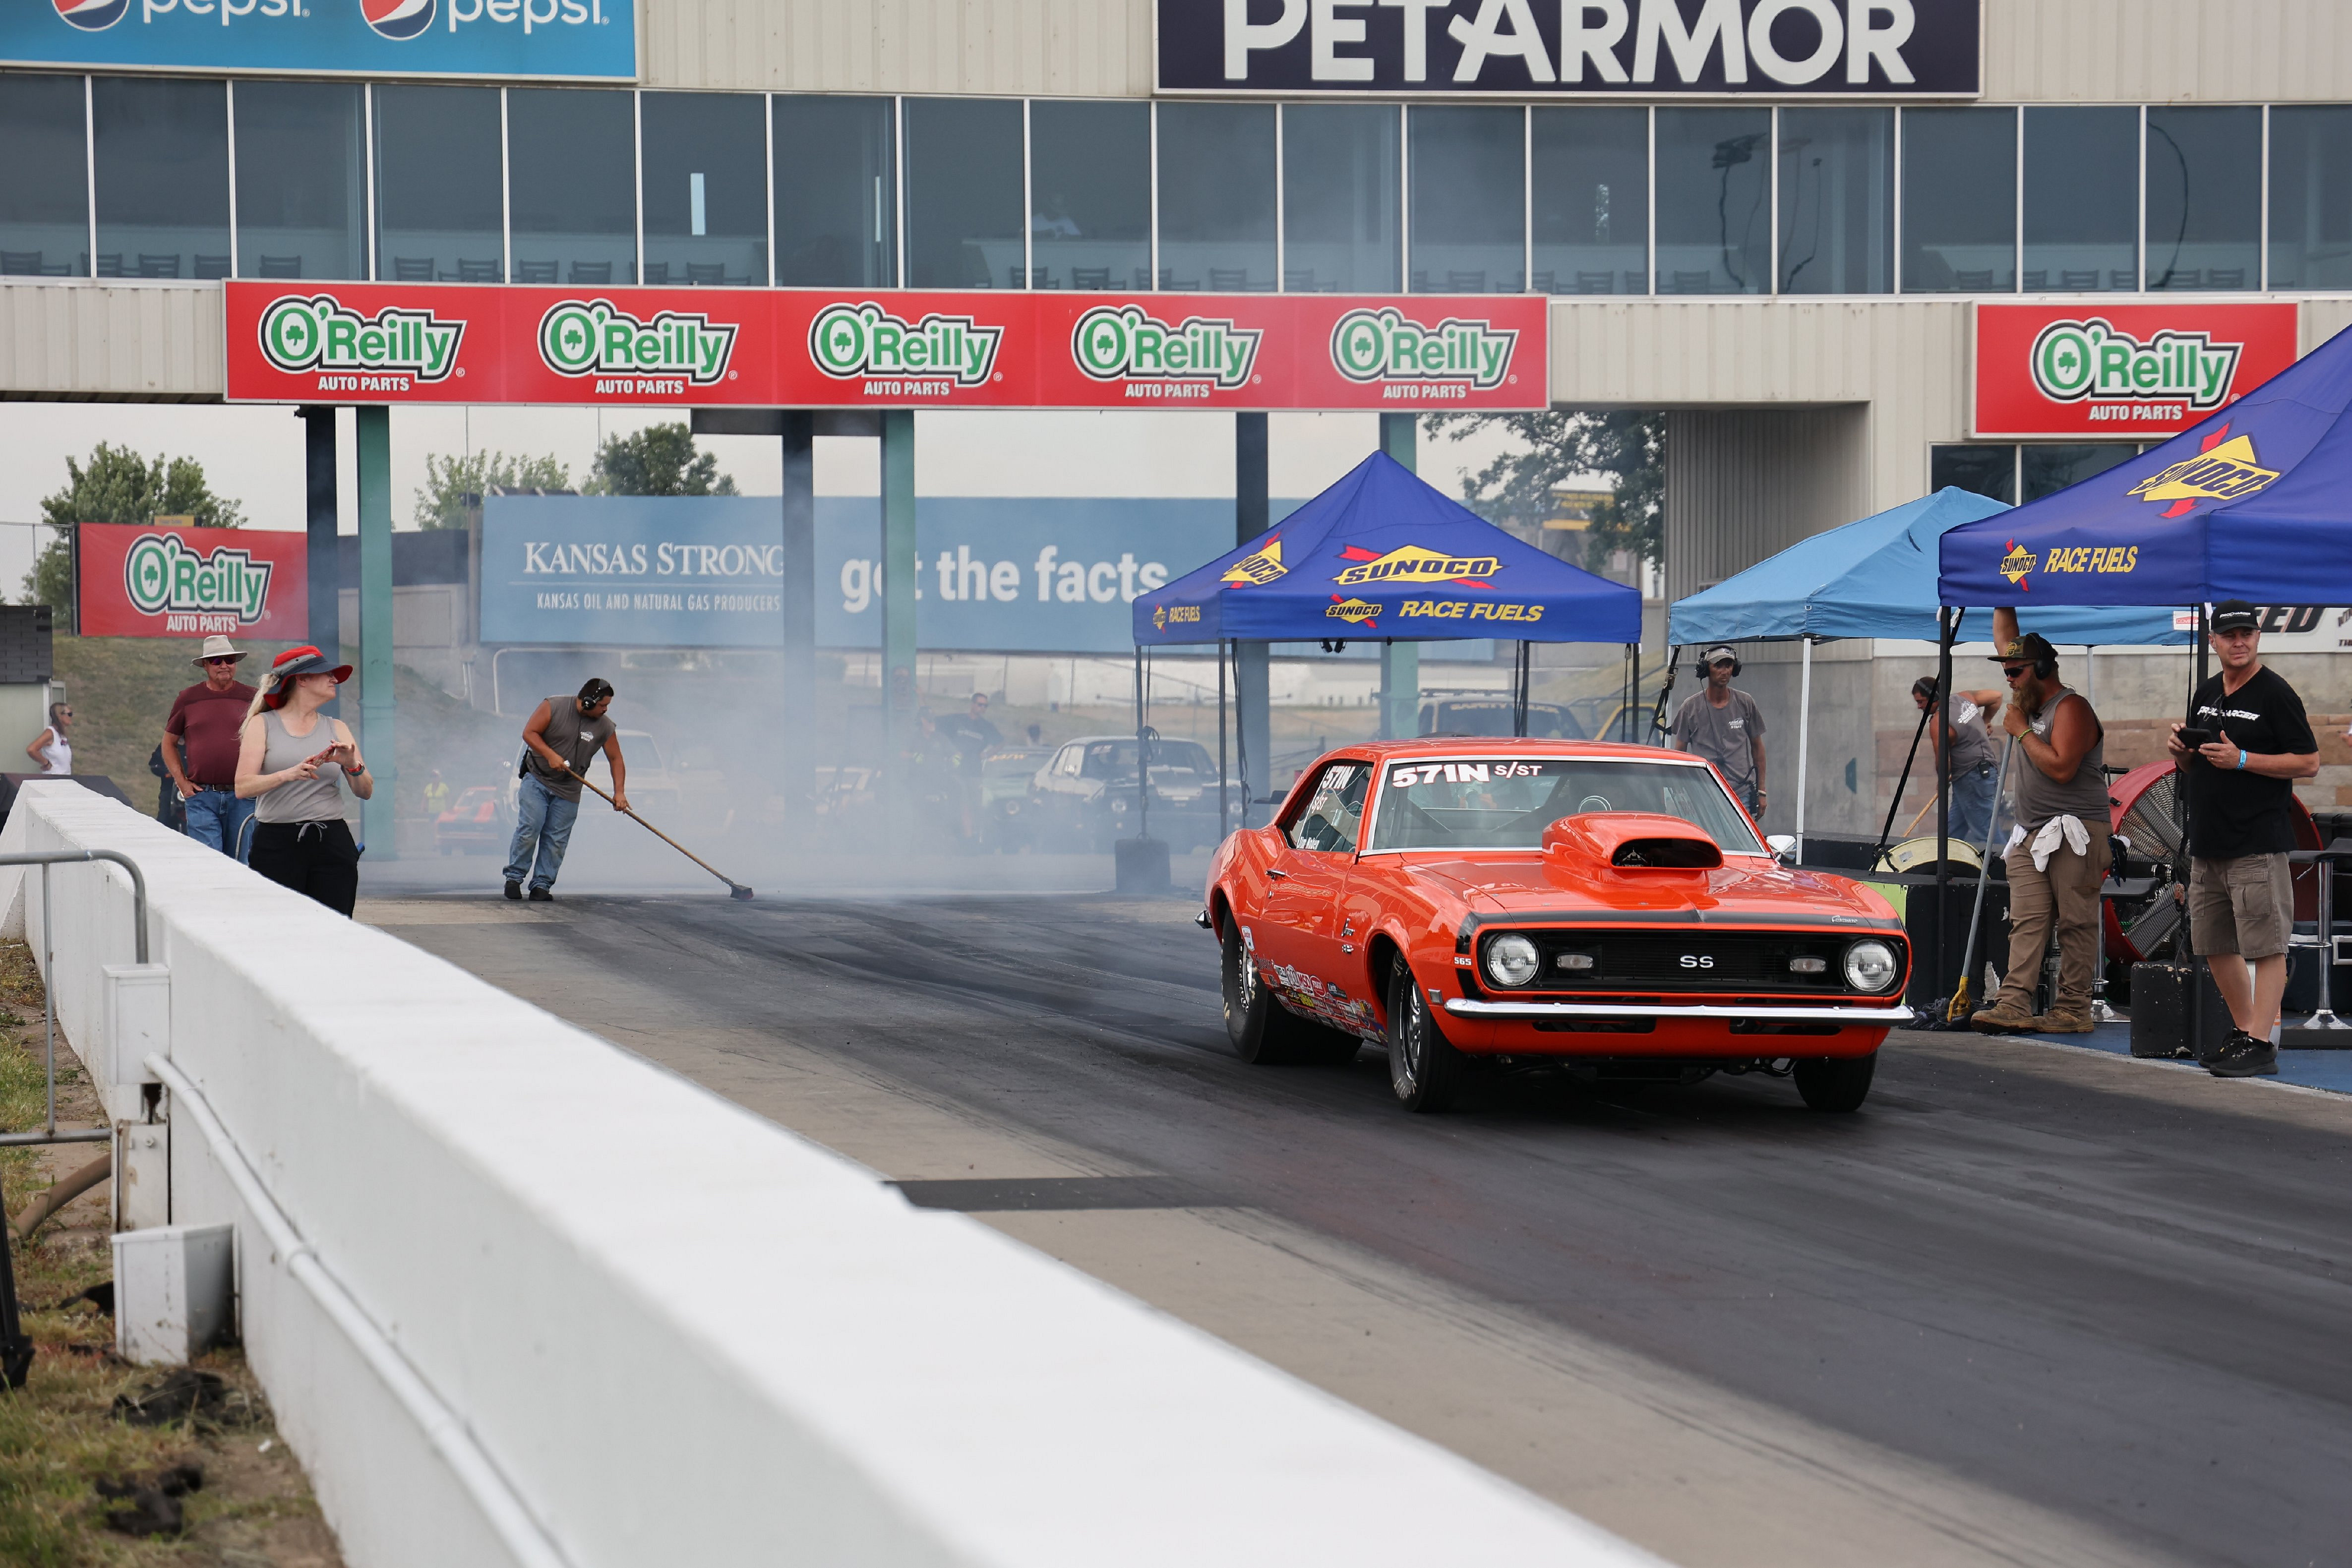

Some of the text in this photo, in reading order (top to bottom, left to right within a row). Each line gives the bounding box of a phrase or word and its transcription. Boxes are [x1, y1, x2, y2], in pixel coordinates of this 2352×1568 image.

[1224, 0, 1916, 84] PETARMOR
[270, 306, 451, 371] O'Reilly
[549, 310, 723, 374] O'Reilly
[819, 313, 989, 376] O'Reilly
[1082, 316, 1247, 378] O'Reilly
[1341, 318, 1504, 379] O'Reilly
[2042, 330, 2226, 398] O'Reilly
[317, 377, 410, 391] AUTO PARTS
[596, 380, 684, 394] AUTO PARTS
[864, 382, 950, 396] AUTO PARTS
[1125, 384, 1209, 398] AUTO PARTS
[1383, 385, 1466, 399] AUTO PARTS
[2089, 406, 2182, 421] AUTO PARTS
[524, 543, 784, 576] KANSAS STRONG
[2002, 546, 2138, 573] SUNOCO RACE FUELS
[133, 544, 263, 612] O'Reilly
[937, 545, 1021, 601] the
[1035, 545, 1168, 603] facts
[1345, 559, 1494, 582] SUNOCO
[537, 593, 781, 611] KANSAS OIL AND NATURAL GAS PRODUCERS
[1327, 601, 1545, 621] SUNOCO RACE FUELS
[166, 615, 237, 632] AUTO PARTS
[1168, 606, 1185, 623] RACE
[1185, 605, 1201, 622] FUELS
[1495, 762, 1542, 779] S/ST
[1311, 791, 1328, 814] S/ST
[1454, 957, 1472, 965] 565
[1680, 955, 1714, 968] SS
